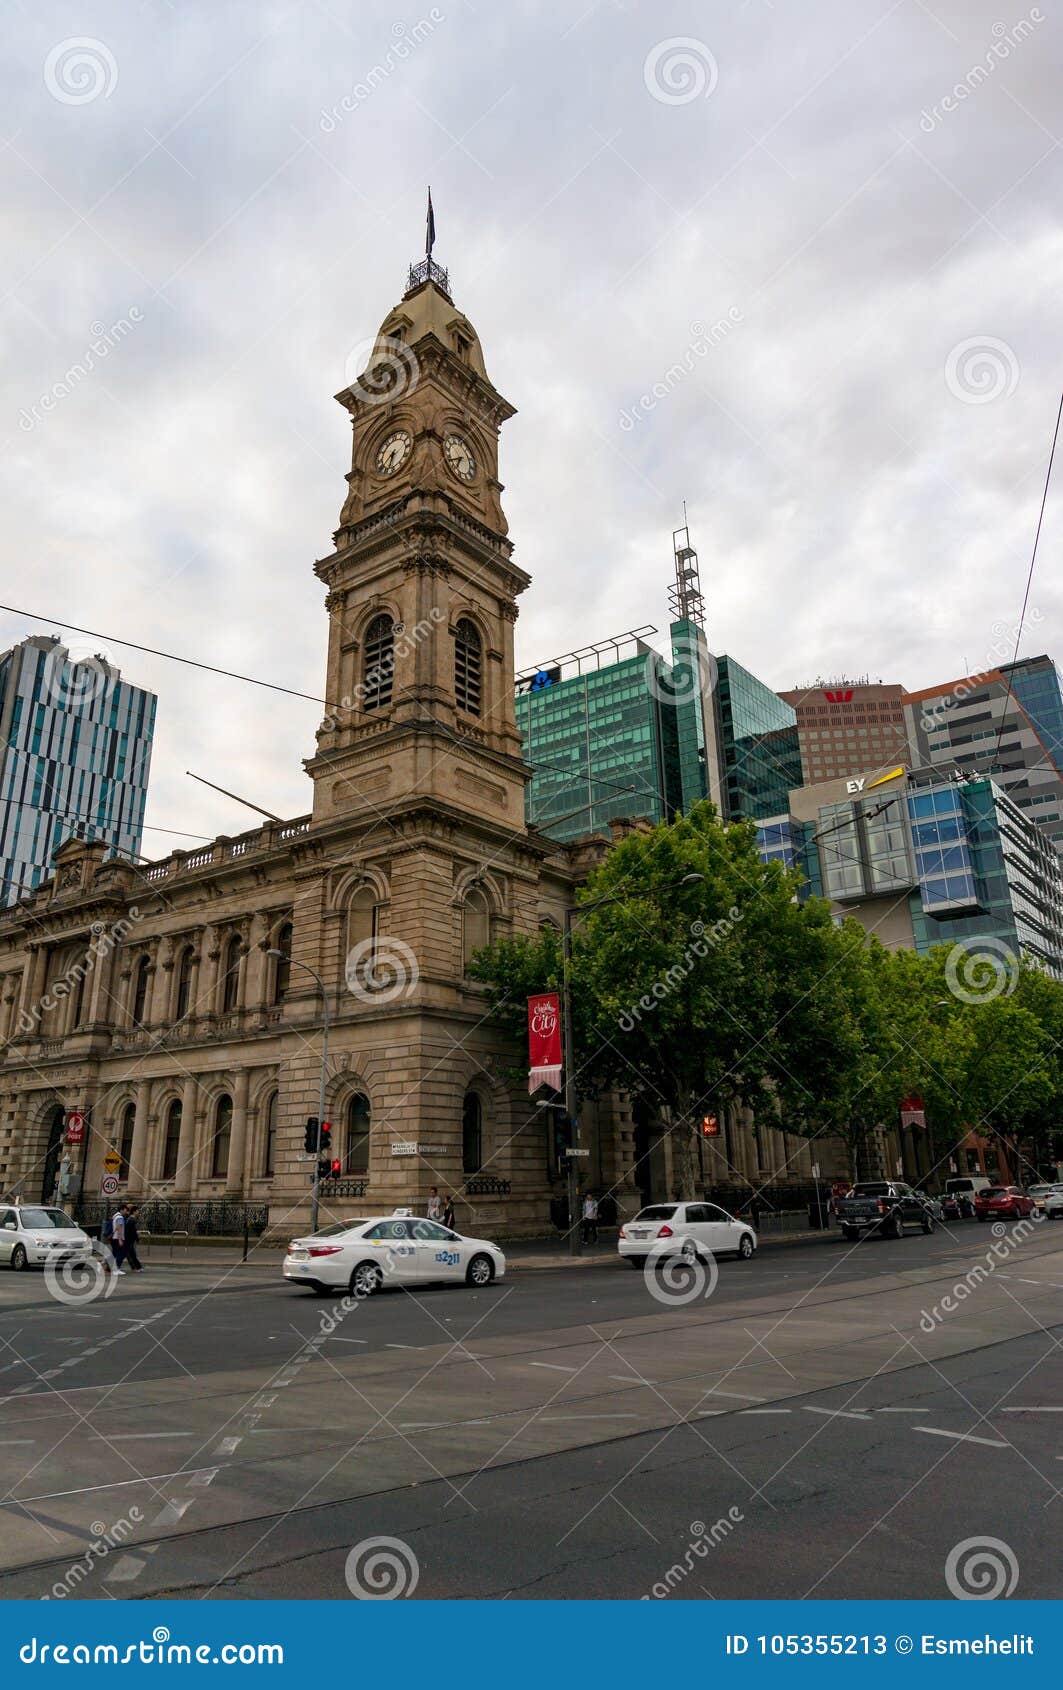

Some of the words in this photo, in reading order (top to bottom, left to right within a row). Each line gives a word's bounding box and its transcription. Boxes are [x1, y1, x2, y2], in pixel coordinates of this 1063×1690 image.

[846, 778, 865, 794] EY
[531, 1014, 556, 1037] City
[105, 1181, 115, 1190] 40
